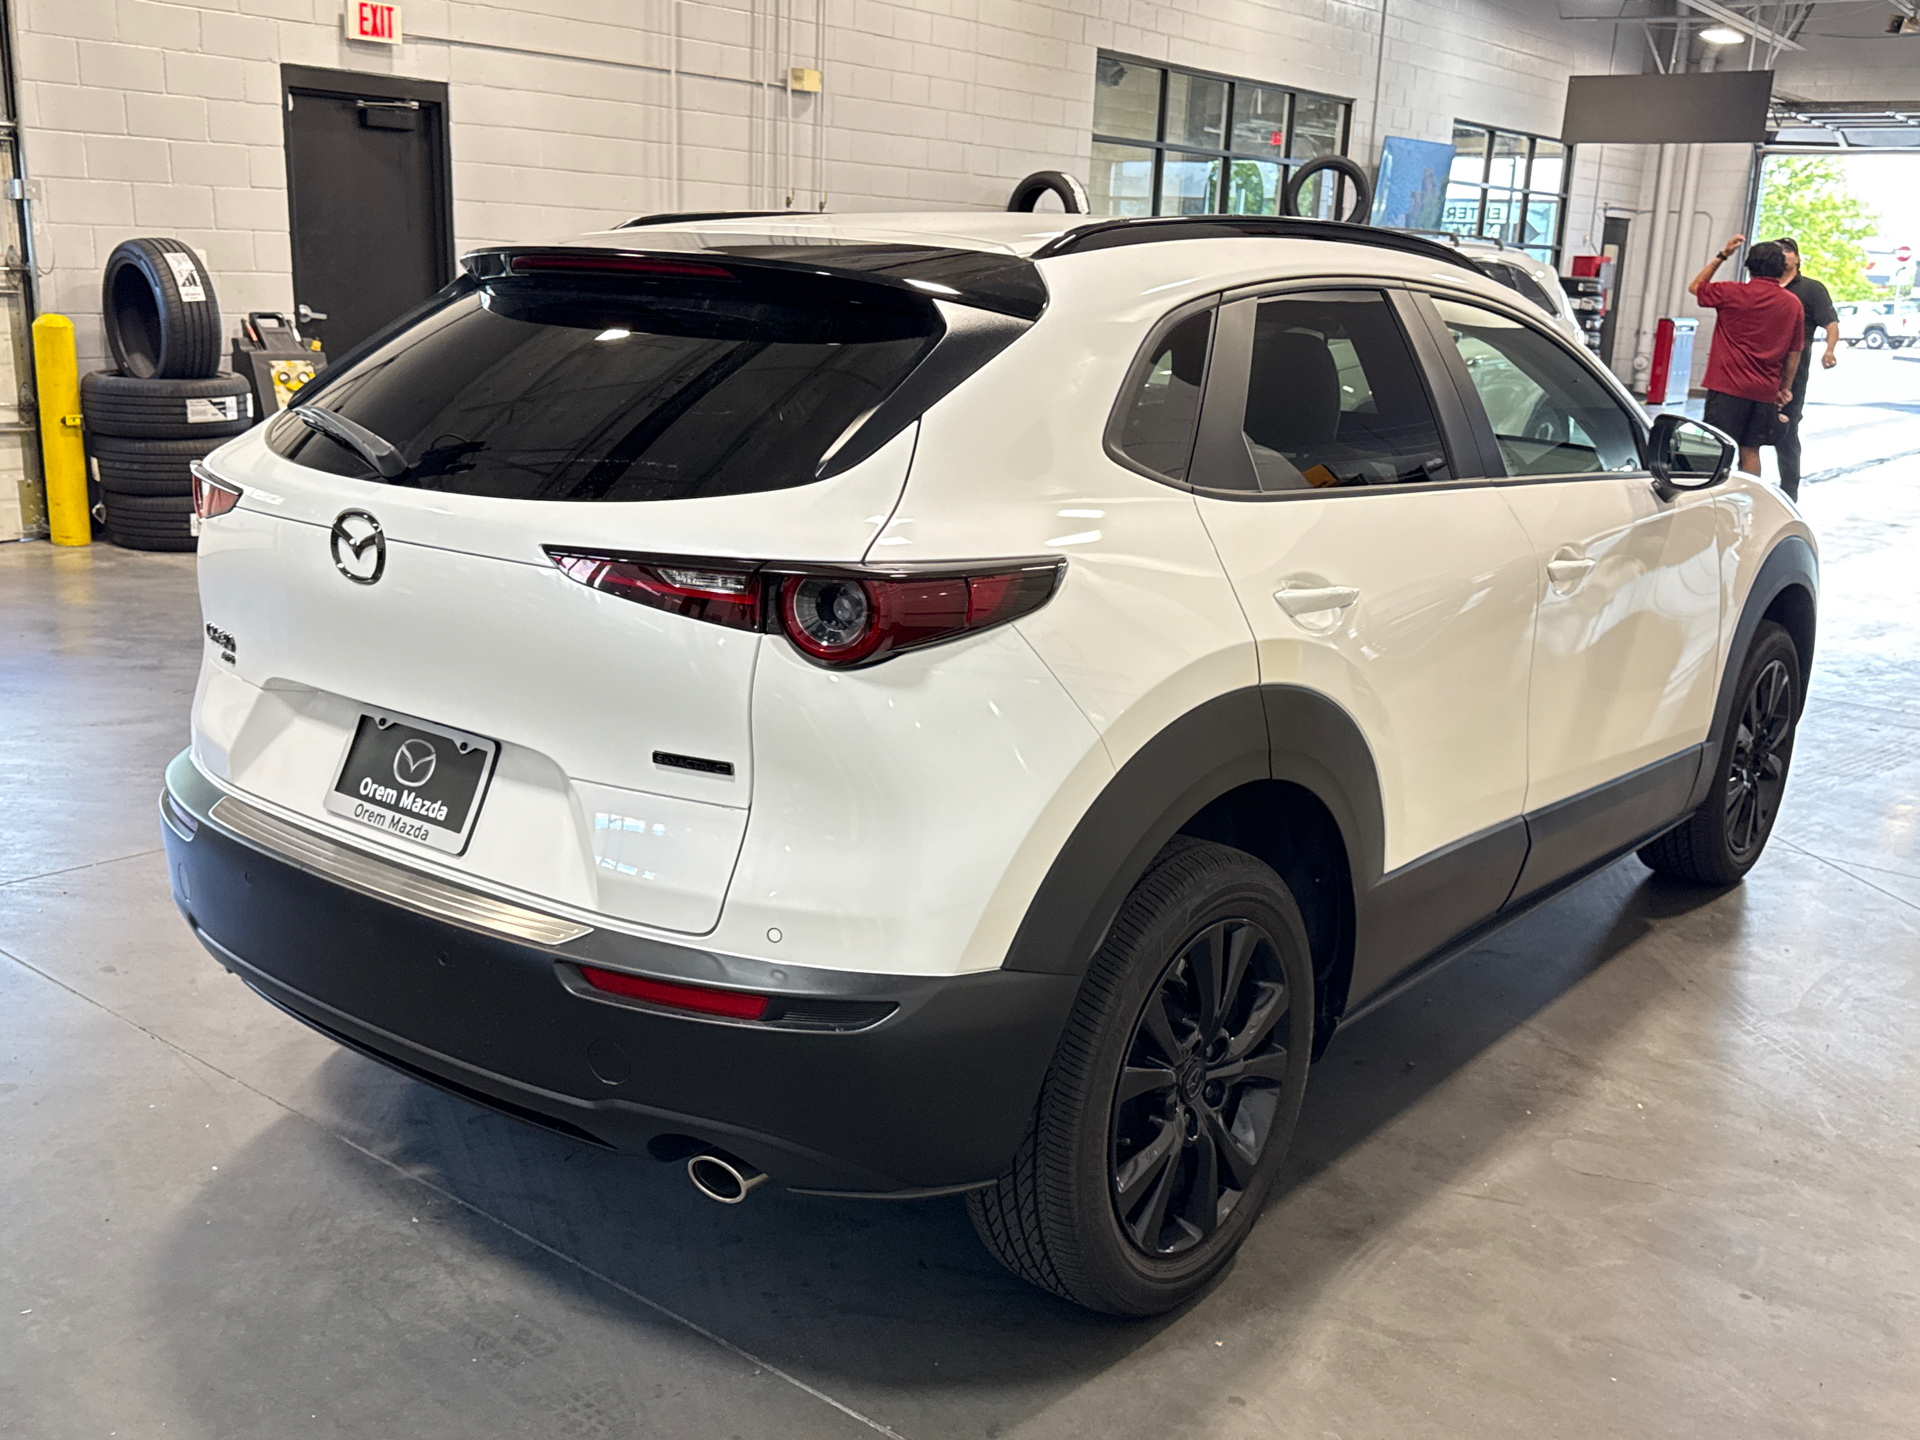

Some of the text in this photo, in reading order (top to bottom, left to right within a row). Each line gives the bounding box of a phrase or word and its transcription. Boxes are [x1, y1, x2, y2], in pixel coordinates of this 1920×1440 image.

[358, 2, 394, 39] EXIT
[359, 776, 449, 821] Orem Mazda
[354, 804, 429, 841] Orem Mazda
